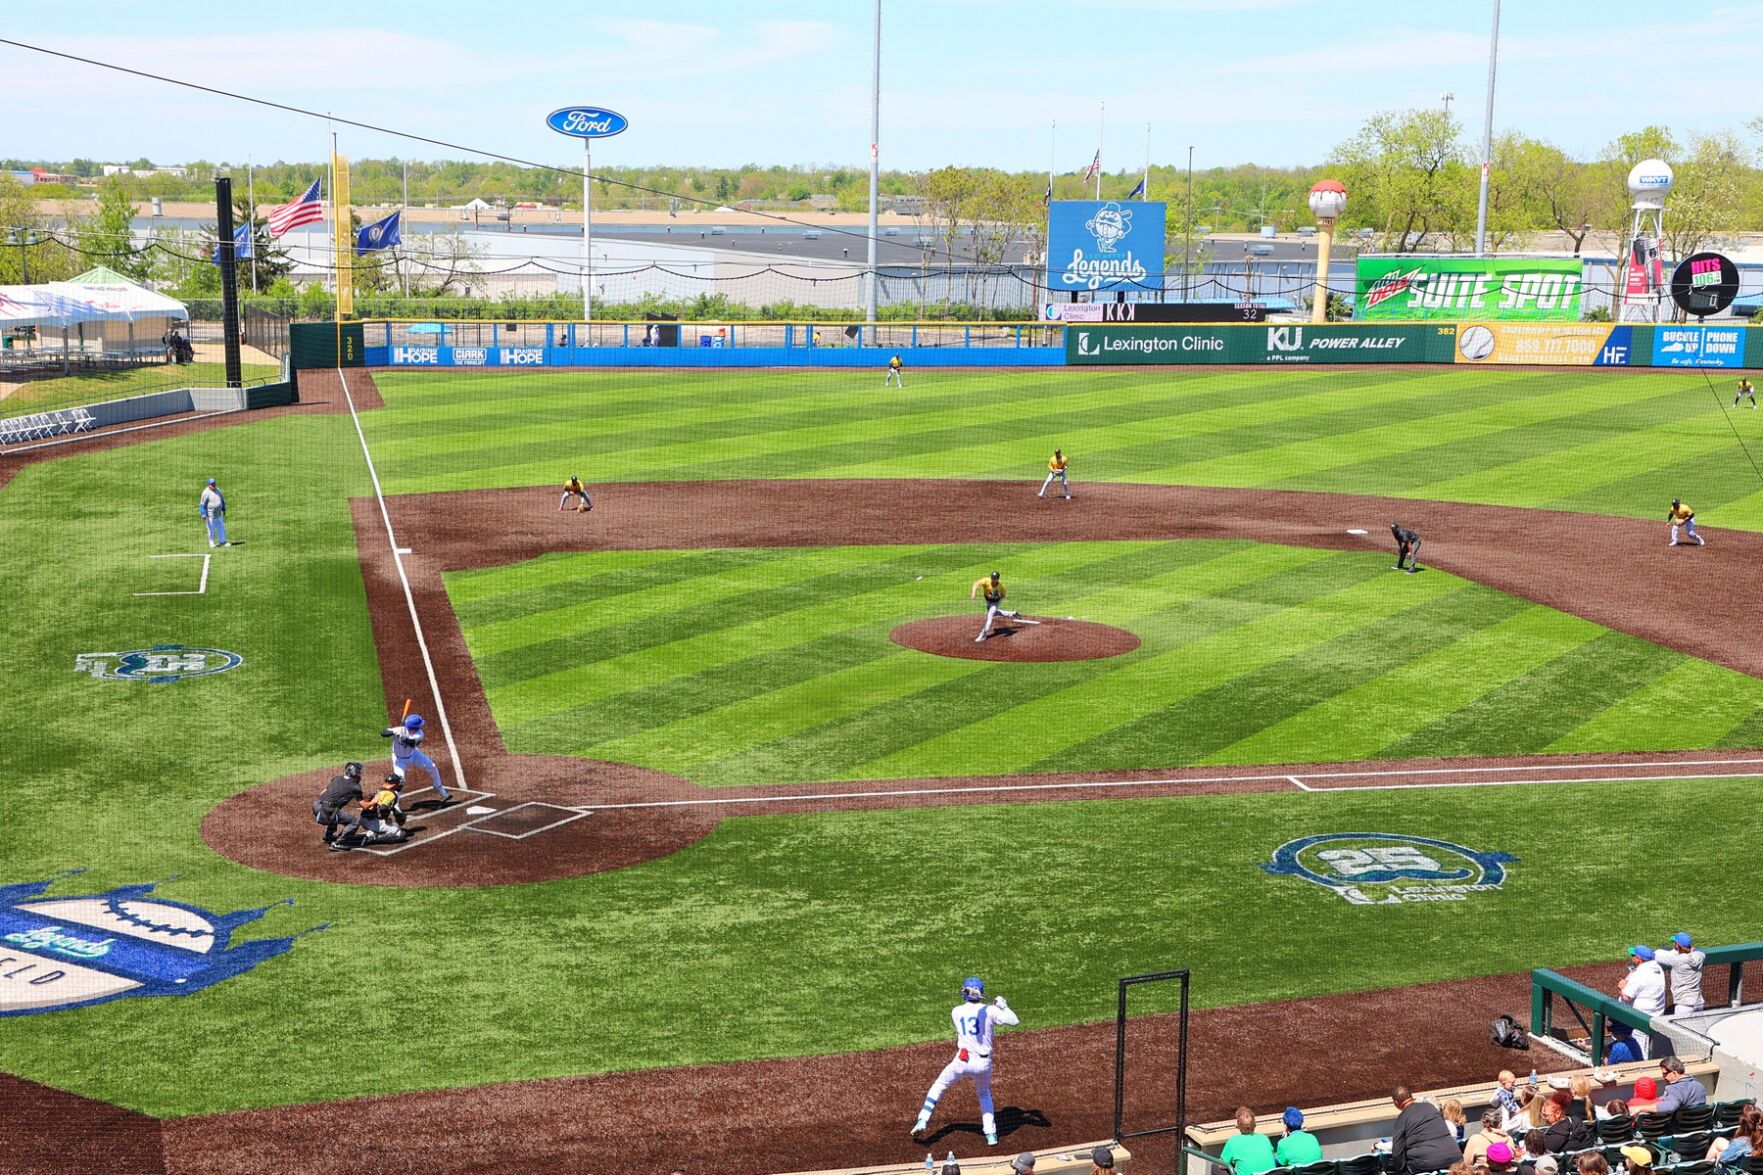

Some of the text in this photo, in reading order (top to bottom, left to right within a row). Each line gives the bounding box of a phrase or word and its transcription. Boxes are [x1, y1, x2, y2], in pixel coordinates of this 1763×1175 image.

[563, 111, 612, 132] Ford
[1063, 249, 1147, 290] Legends
[1691, 258, 1721, 274] HITS
[1407, 273, 1582, 308] SUITE SPOT
[1064, 304, 1101, 313] Lexington
[1243, 309, 1257, 319] 32
[1437, 327, 1456, 335] 382
[1663, 331, 1700, 342] BUCKLE
[1707, 332, 1739, 342] PHONE
[1104, 336, 1224, 353] Lexington Clinic
[1267, 327, 1303, 351] KU
[1309, 337, 1406, 349] POWER ALLEY
[394, 348, 438, 363] HOPE
[455, 350, 484, 359] CLARK
[1685, 343, 1699, 353] UP
[1706, 343, 1736, 354] DOWN
[501, 348, 543, 364] HOPE
[1316, 846, 1441, 876] 25
[960, 1016, 980, 1036] 13
